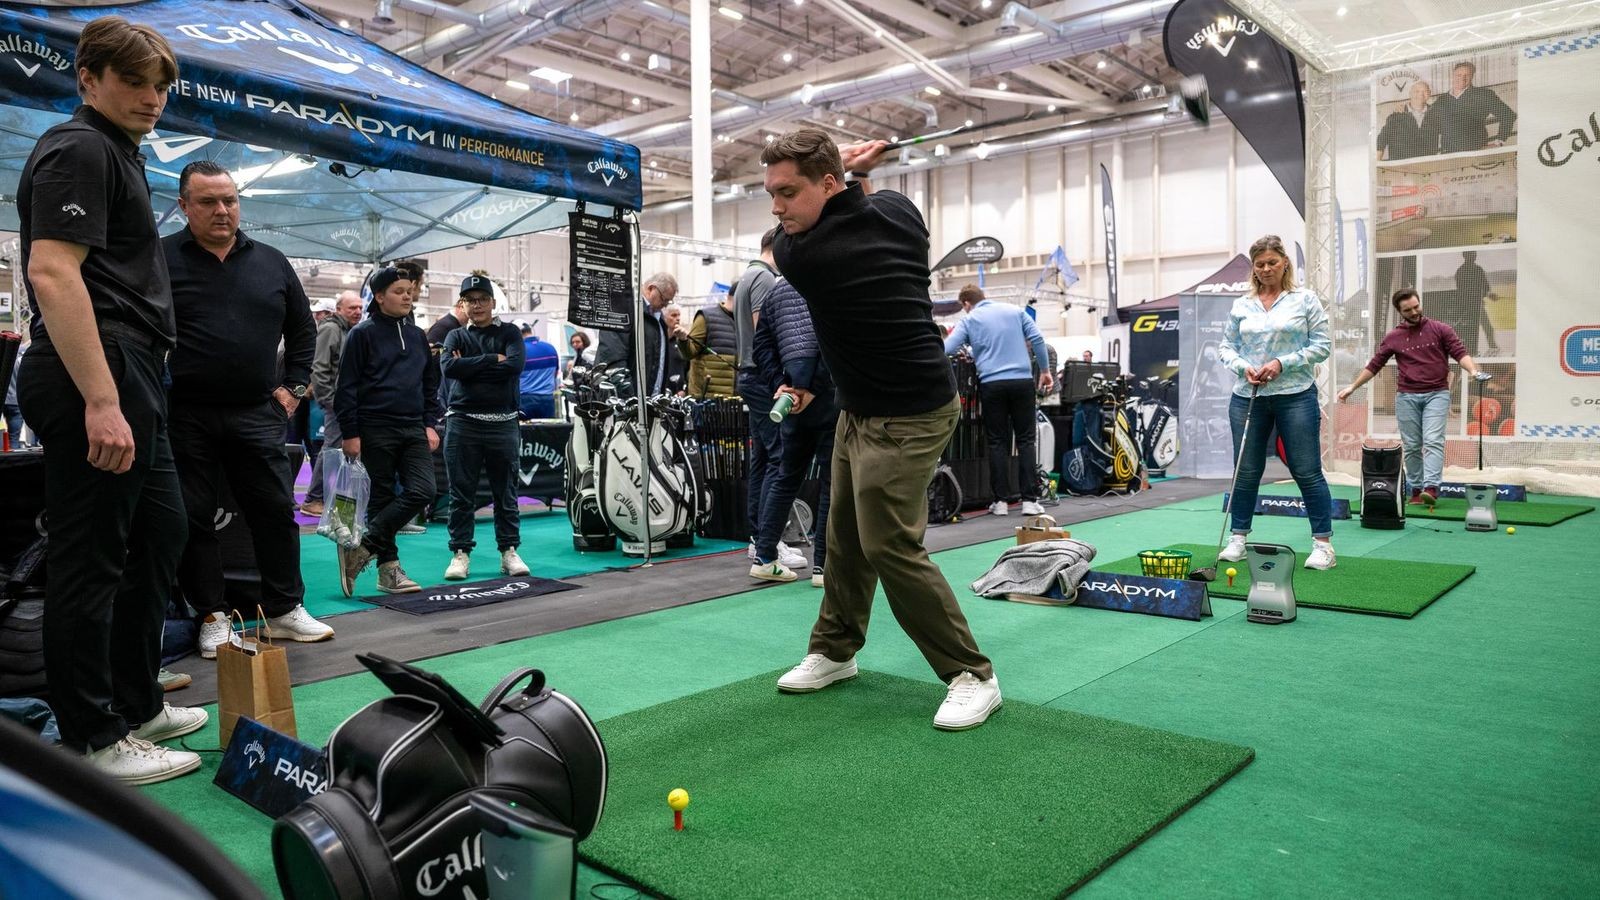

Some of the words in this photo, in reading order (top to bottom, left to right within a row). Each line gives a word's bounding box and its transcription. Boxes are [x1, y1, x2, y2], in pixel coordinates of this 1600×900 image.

[0, 34, 71, 71] allaway
[176, 20, 427, 88] Callaway
[168, 79, 192, 97] HE
[197, 83, 236, 105] NEW
[245, 93, 435, 145] PARADYM
[442, 133, 456, 150] IN
[459, 136, 545, 167] PERFORMANCE
[1537, 112, 1600, 168] Cal
[587, 157, 628, 180] Callaway
[470, 277, 480, 287] P
[1133, 314, 1180, 333] G43
[1335, 328, 1364, 340] ING
[1582, 338, 1600, 352] ME
[1582, 355, 1599, 365] DAS
[519, 438, 564, 469] laway
[613, 492, 639, 526] Callaway
[1261, 498, 1306, 509] PARA
[1079, 580, 1176, 601] ARADYM
[273, 757, 329, 796] PARA
[416, 831, 486, 897] Call
